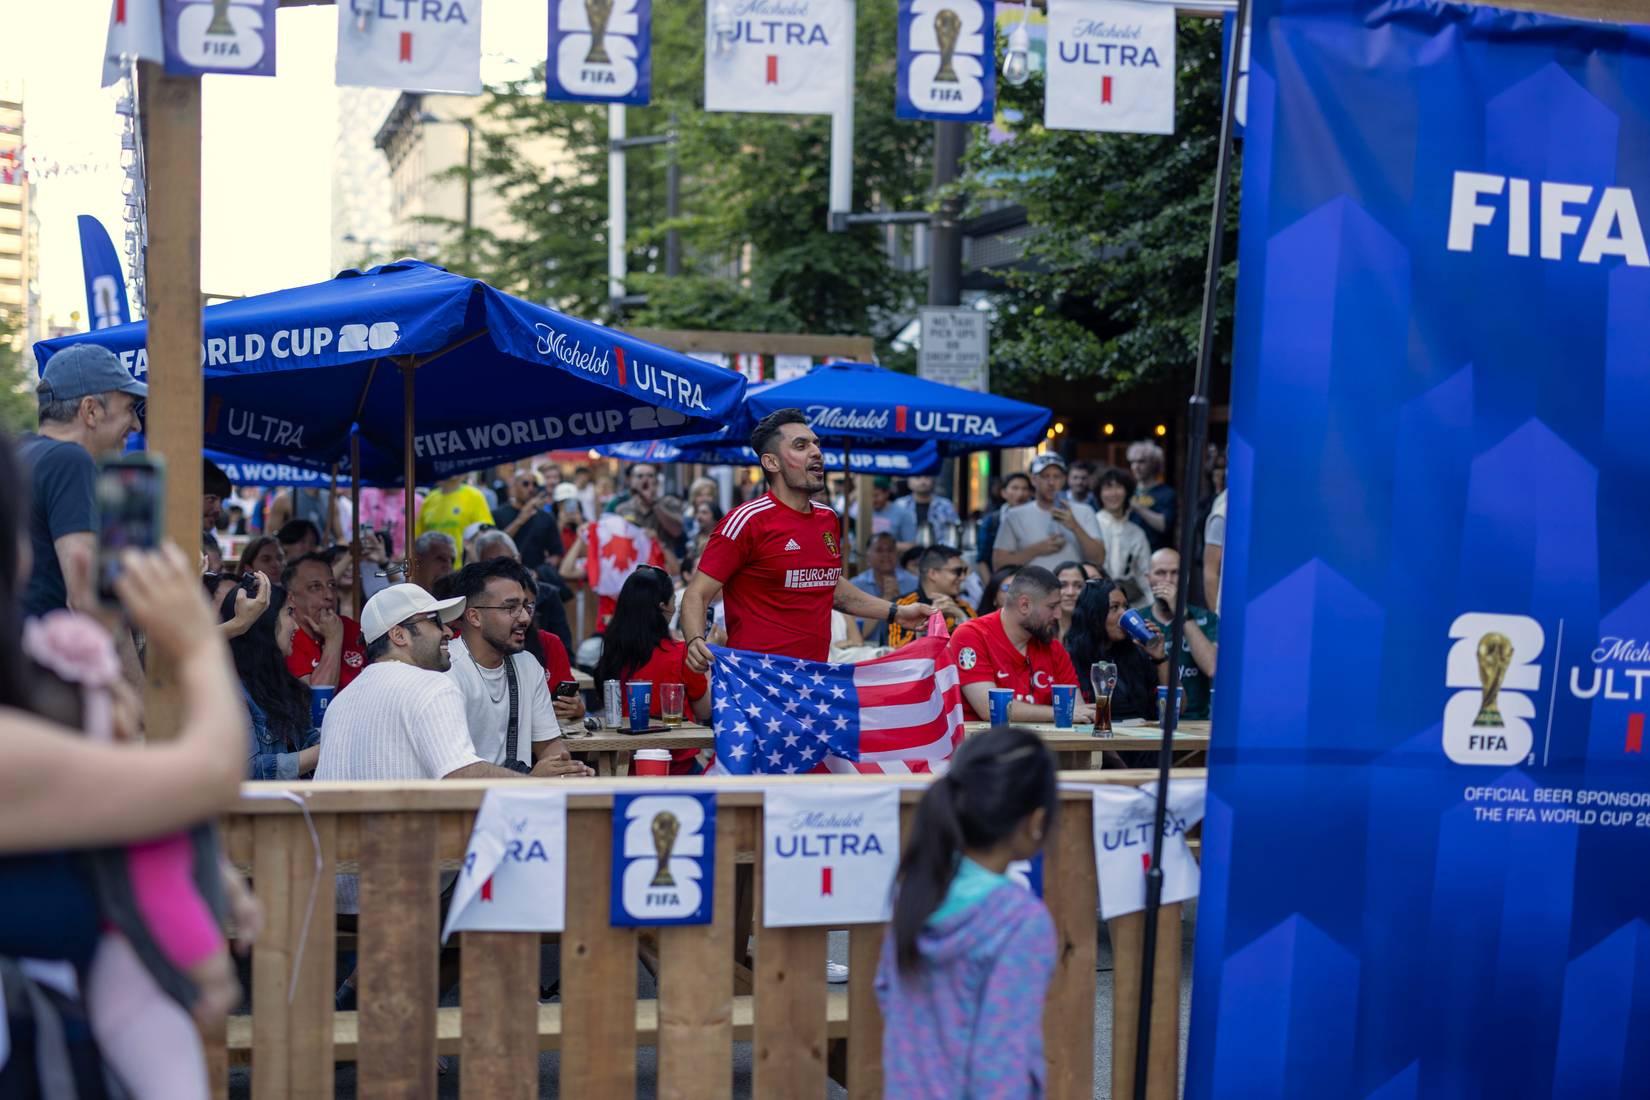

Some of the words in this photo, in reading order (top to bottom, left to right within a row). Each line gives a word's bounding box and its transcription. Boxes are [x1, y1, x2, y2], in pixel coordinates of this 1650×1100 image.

[203, 41, 240, 55] FIFA
[1059, 41, 1160, 68] ULTRA
[581, 70, 615, 83] FIFA
[931, 88, 962, 101] FIFA
[1447, 170, 1650, 267] FIFA
[112, 348, 149, 377] FA
[201, 333, 266, 369] RLD
[271, 328, 333, 358] CUP
[535, 323, 609, 376] Michelob
[633, 360, 708, 410] ULTRA
[228, 398, 304, 448] ULTRA
[414, 429, 466, 457] FIFA
[467, 416, 563, 450] WORLD
[568, 409, 624, 434] CUP
[805, 405, 889, 429] Michelob
[915, 411, 1000, 437] ULTRA
[799, 568, 842, 582] EURO-RIT
[1591, 636, 1650, 663] Mich
[1569, 666, 1650, 700] ULT
[1468, 734, 1508, 751] FIFA
[1464, 786, 1529, 802] OFFICIAL
[1533, 788, 1573, 804] BEER
[1576, 790, 1650, 807] SPONSOR
[1474, 807, 1503, 822] THE
[1506, 808, 1537, 823] FIFA
[1540, 809, 1597, 825] WORLD
[1600, 811, 1633, 827] CUP
[775, 833, 884, 858] ULTRA
[646, 893, 681, 906] FIFA
